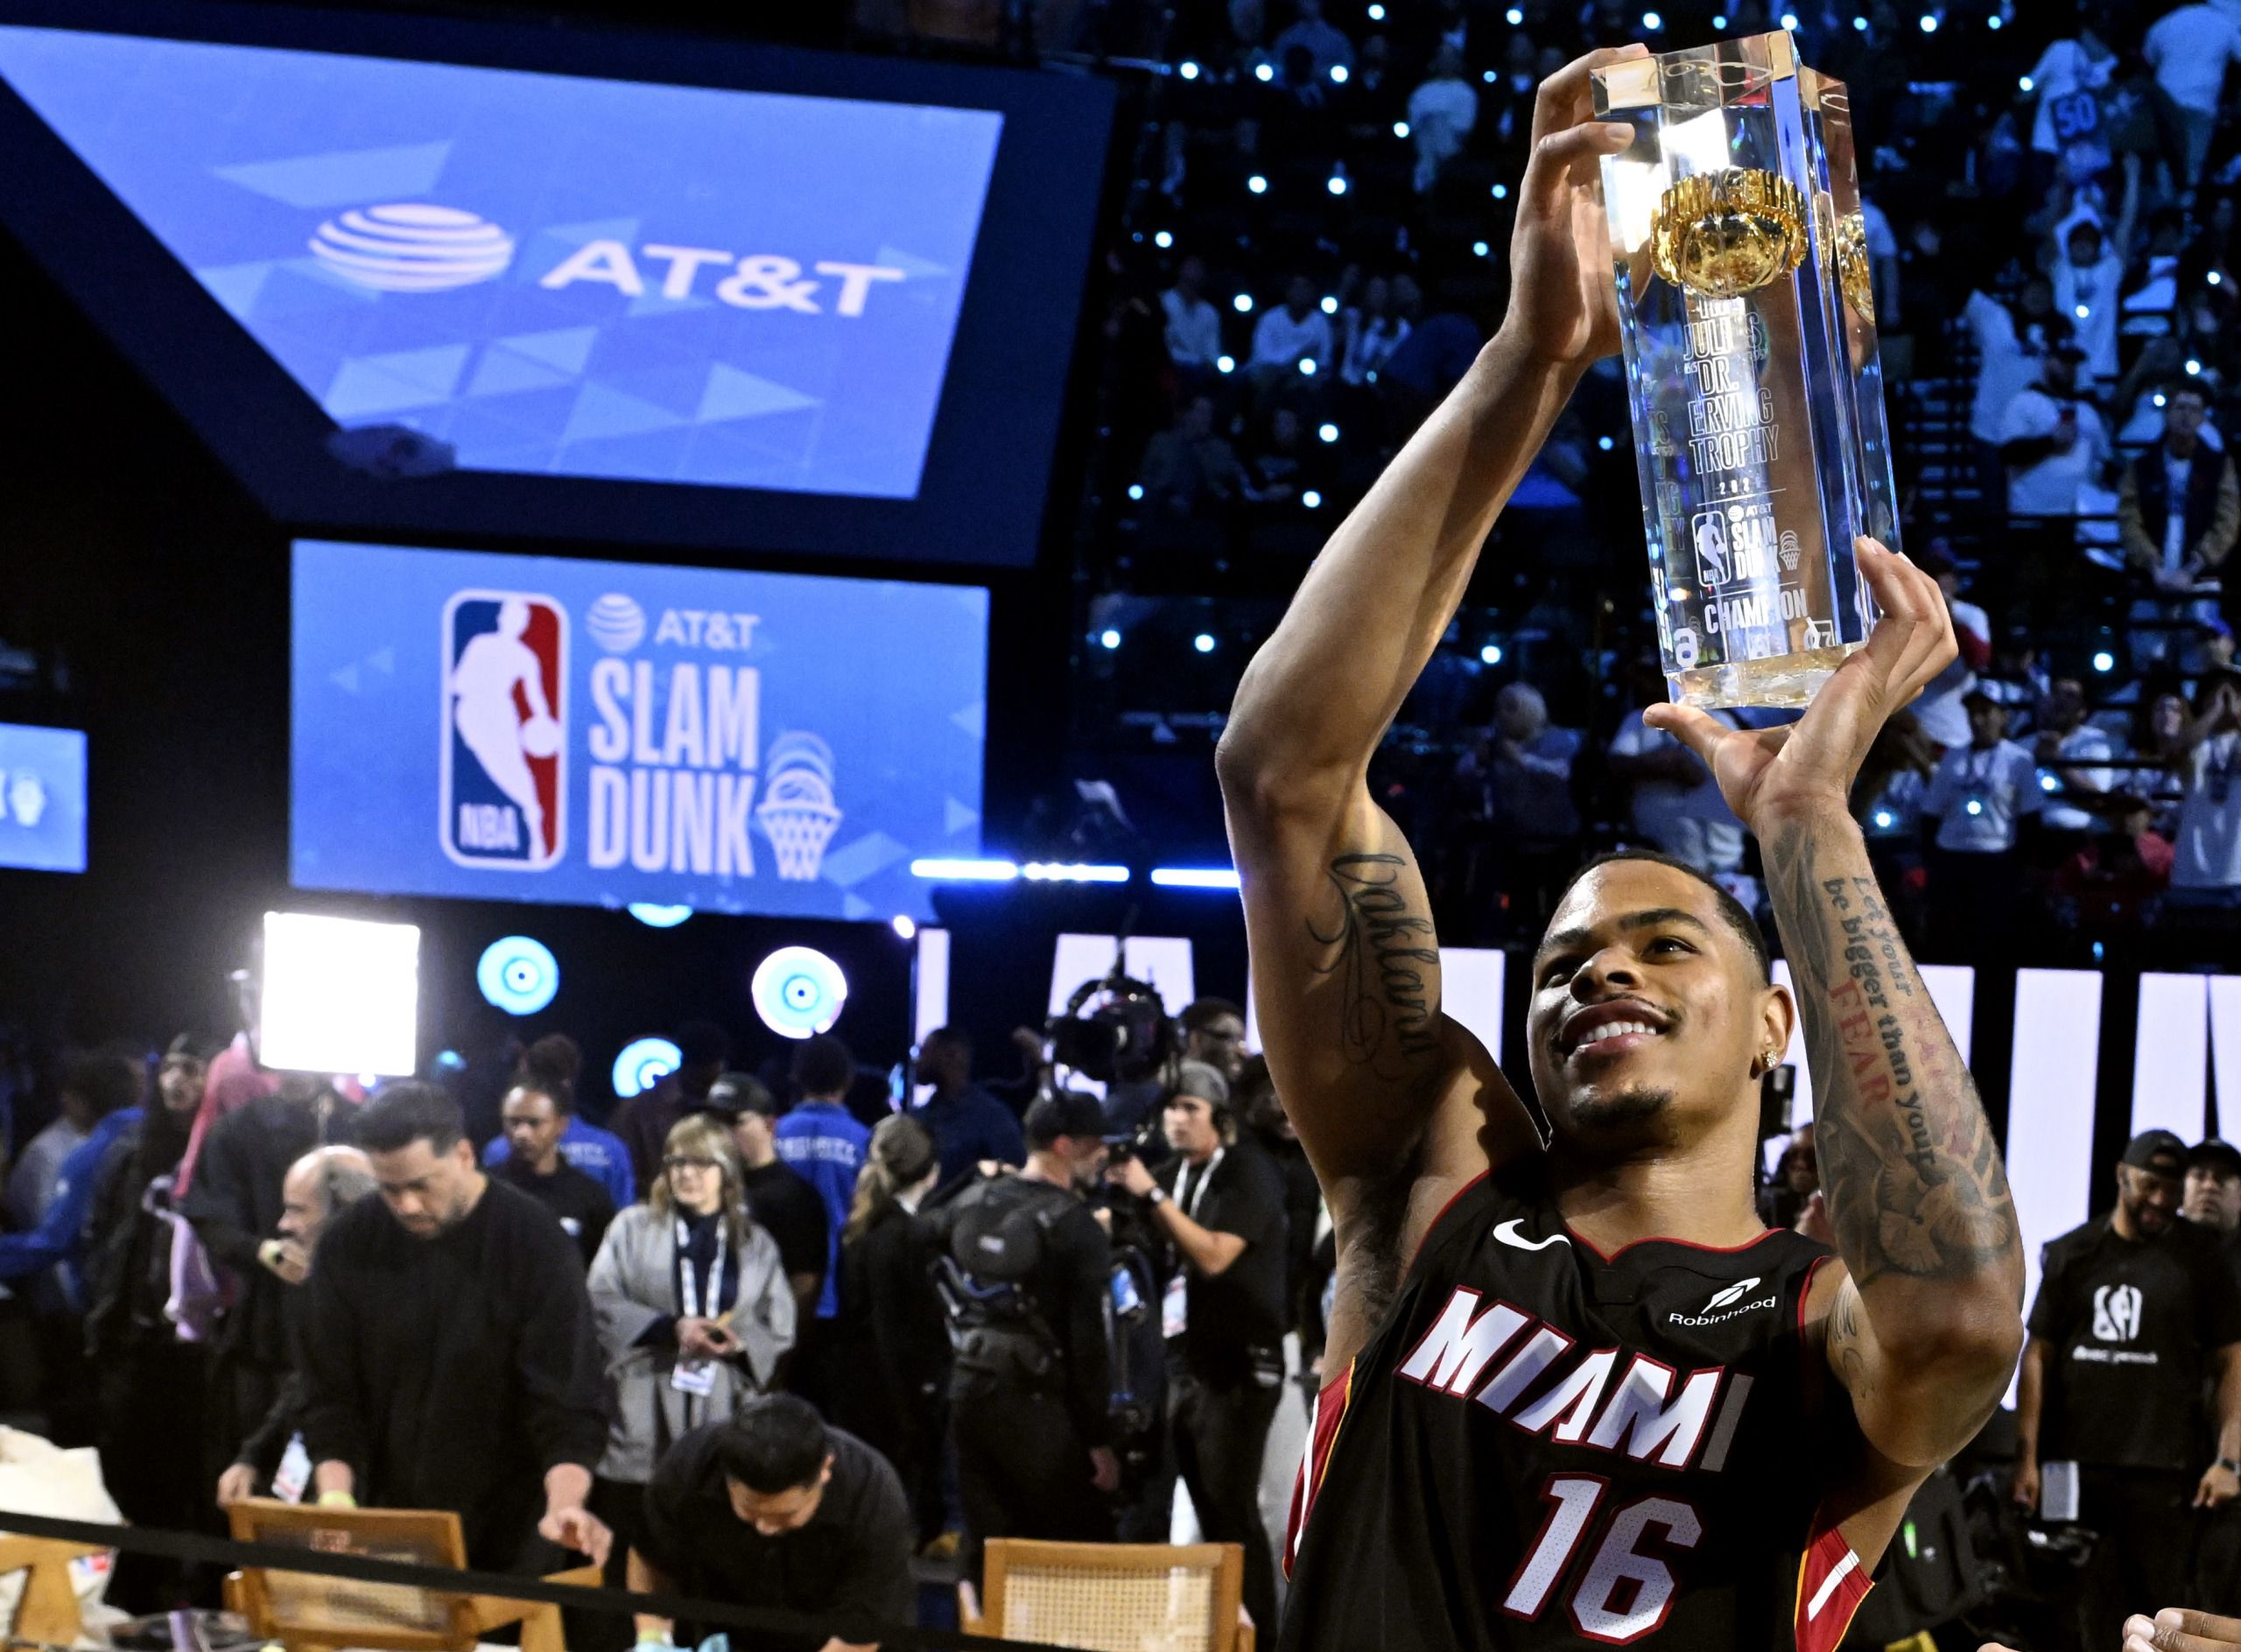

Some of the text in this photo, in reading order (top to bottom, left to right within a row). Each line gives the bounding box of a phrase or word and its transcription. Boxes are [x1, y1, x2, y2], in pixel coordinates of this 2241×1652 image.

[539, 239, 906, 317] AT&T
[1683, 312, 1763, 361] JULIS
[1688, 387, 1774, 437] ERVING
[1689, 424, 1780, 475] TROPHY
[1731, 516, 1778, 552] SLAM
[1746, 503, 1774, 517] AT&T
[654, 609, 761, 650] AT&T
[588, 657, 760, 771] SLAM
[458, 803, 519, 851] NBA
[587, 765, 756, 877] DUNK
[1851, 876, 1913, 997] Let your
[1823, 877, 1936, 1164] be bigger than your
[1828, 976, 1891, 1110] FEAR
[1668, 1296, 1776, 1326] Robinhood
[1393, 1284, 1754, 1473] MIAMI
[1494, 1472, 1707, 1646] 16
